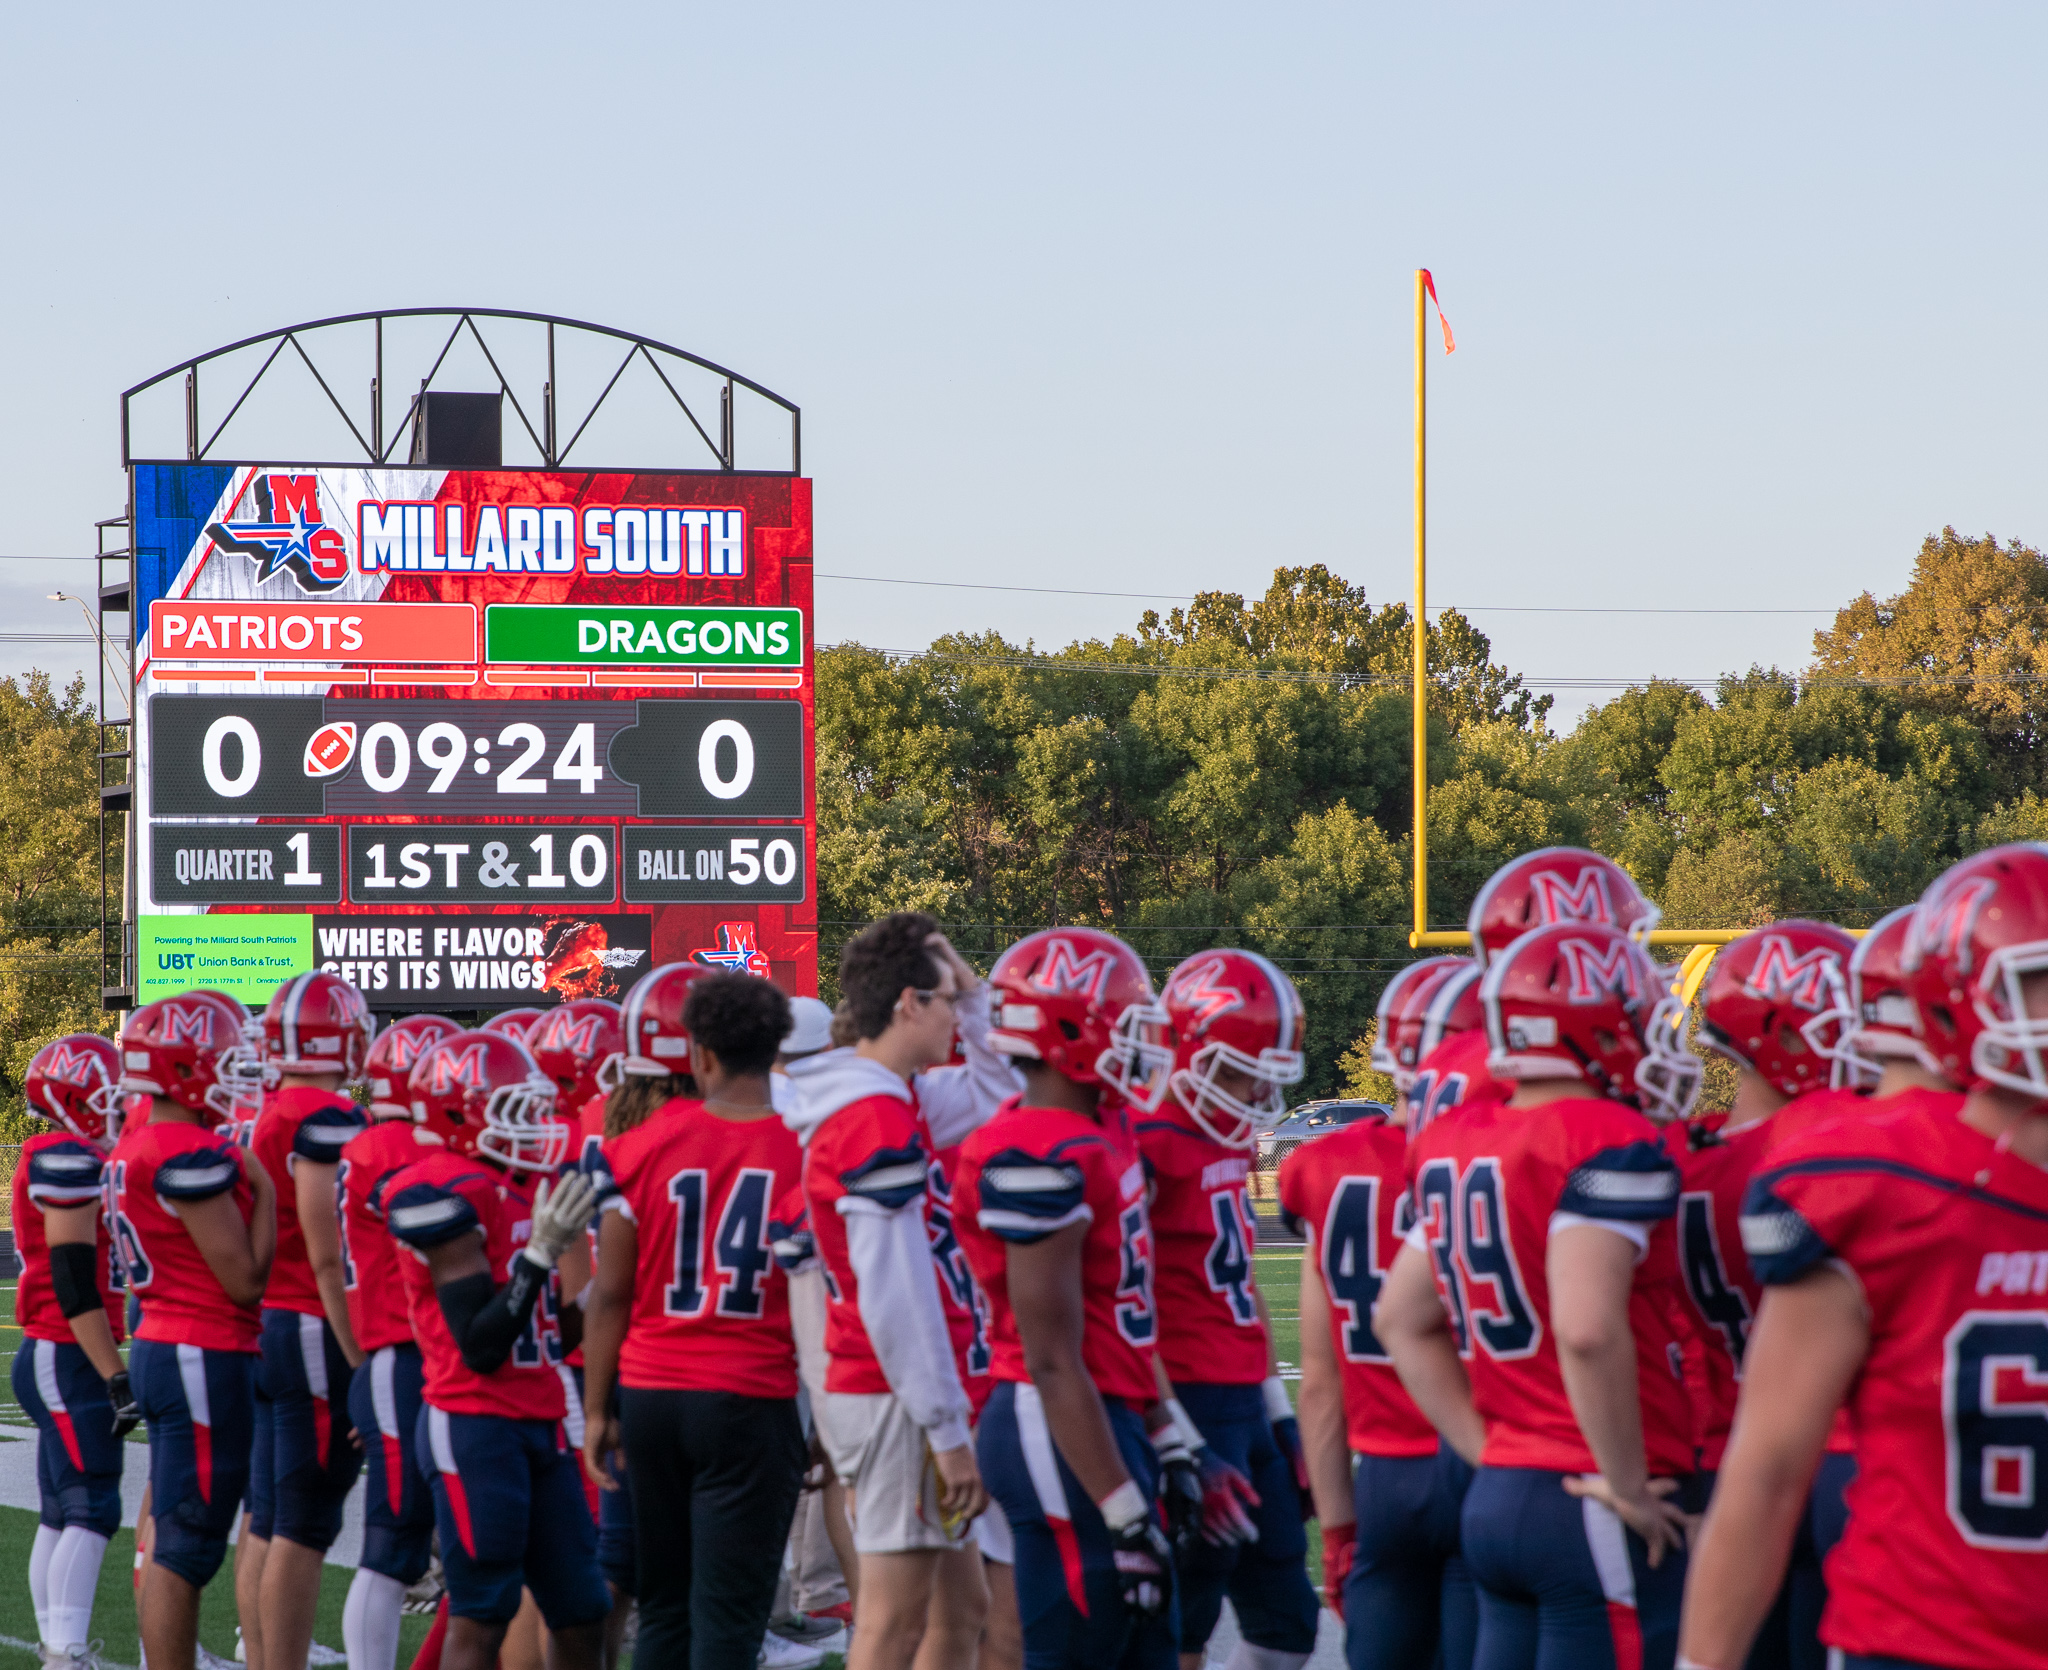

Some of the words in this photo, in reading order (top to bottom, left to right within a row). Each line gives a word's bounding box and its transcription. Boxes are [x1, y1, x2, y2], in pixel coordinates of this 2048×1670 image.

[360, 503, 578, 573] MILLARD
[582, 506, 744, 576] SOUTH
[162, 615, 364, 651] PATRIOTS
[578, 619, 790, 656] DRAGONS
[202, 715, 262, 799] 0
[360, 722, 603, 795] 09:24
[698, 719, 755, 800] 0
[175, 848, 274, 885] QUARTER
[284, 832, 322, 886] 1
[364, 843, 470, 888] 1ST
[477, 841, 521, 888] &
[527, 833, 607, 888] 10
[638, 849, 691, 880] BALL
[696, 849, 723, 880] ON
[727, 838, 796, 886] 50
[1530, 866, 1618, 926] M
[154, 936, 193, 946] Powering
[195, 936, 209, 944] the
[210, 936, 239, 944] Millard
[241, 936, 265, 944] South
[266, 936, 297, 944] Patriots
[158, 953, 195, 970] UBT
[198, 956, 228, 967] Union
[230, 956, 257, 967] Bank
[318, 927, 423, 957] WHERE
[434, 927, 545, 957] FLAVOR
[320, 960, 388, 990] GETS
[400, 961, 440, 990] ITS
[1034, 938, 1118, 1005] M
[1559, 938, 1645, 1005] M
[1743, 934, 1841, 1013] M
[159, 1003, 215, 1048] M
[390, 1026, 443, 1073] M
[543, 1009, 607, 1059] M
[44, 1043, 100, 1088] M
[431, 1043, 489, 1096] M
[663, 1167, 776, 1320] 14
[1204, 1187, 1258, 1327] 4
